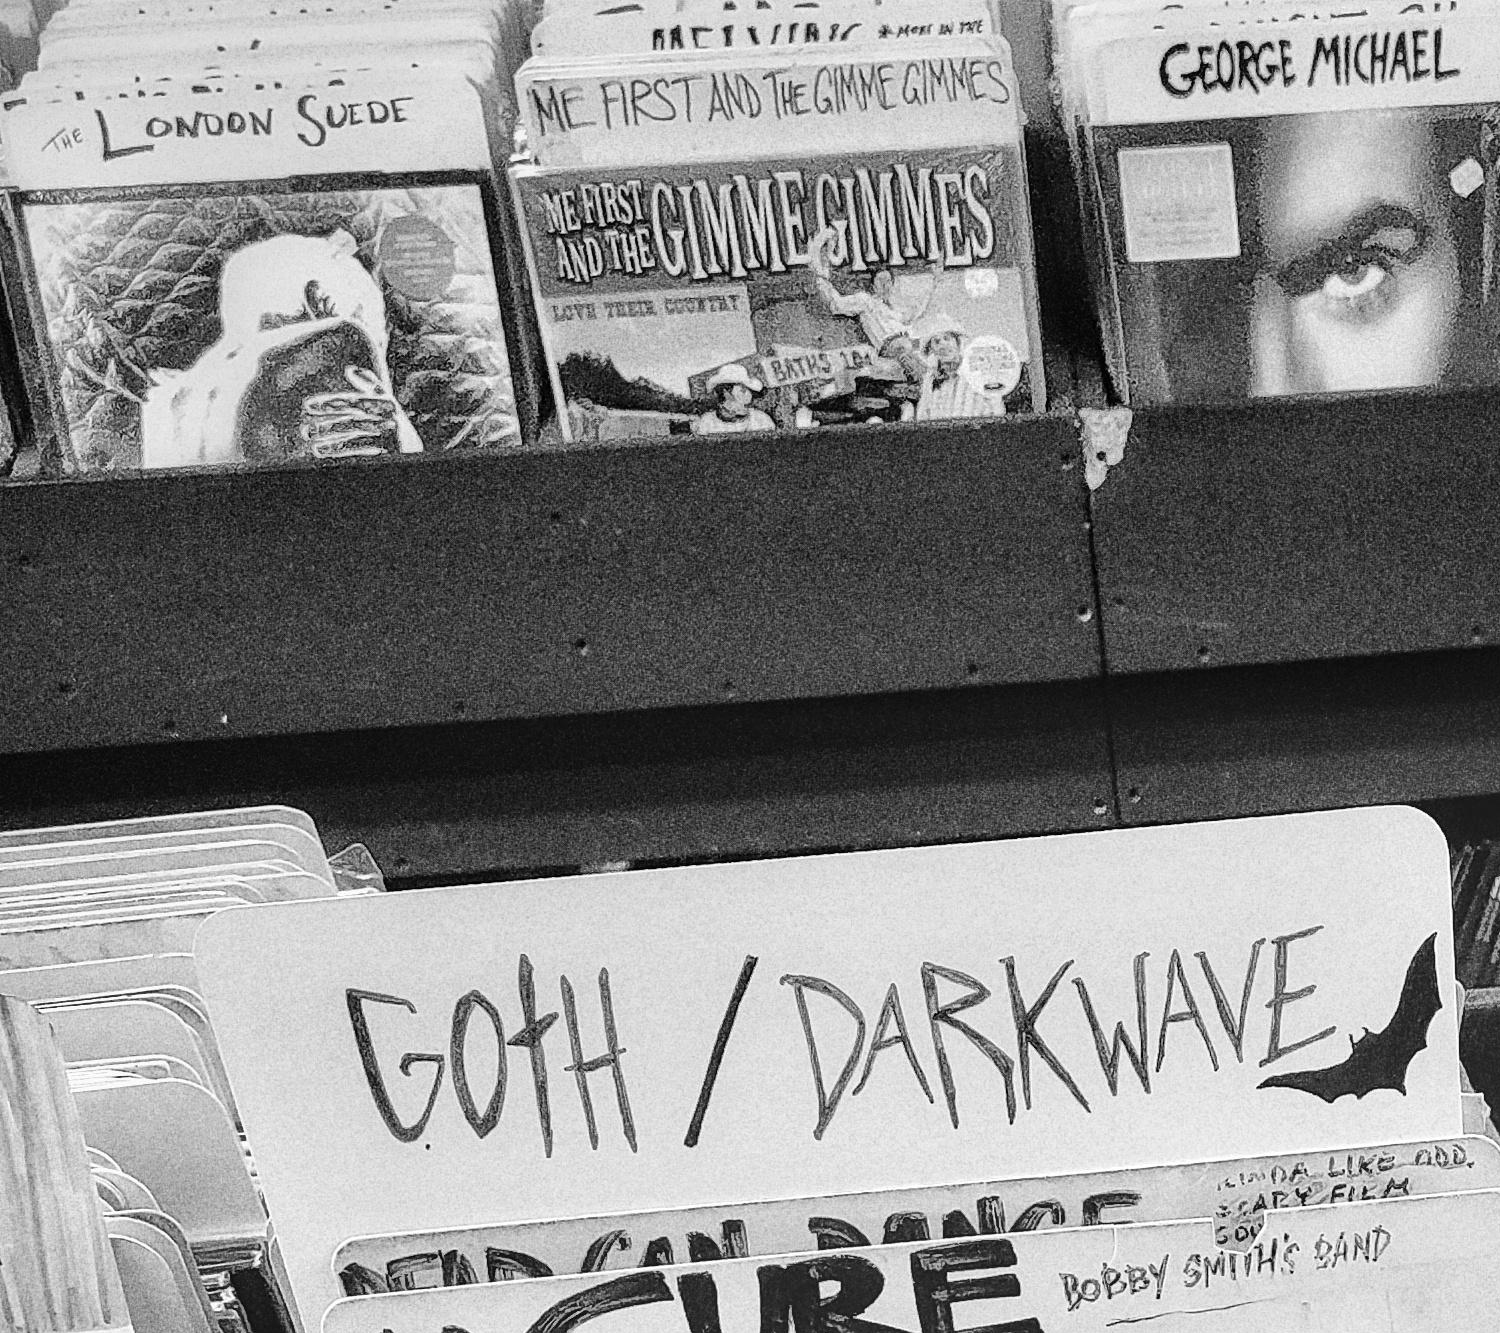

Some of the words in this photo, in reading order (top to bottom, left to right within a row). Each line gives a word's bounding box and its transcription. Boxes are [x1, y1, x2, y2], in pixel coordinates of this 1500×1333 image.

[527, 84, 597, 137] ME
[600, 75, 703, 128] FIRST
[708, 71, 763, 123] AND
[814, 63, 896, 115] GIMME
[902, 56, 1011, 107] GIMMES
[1160, 39, 1296, 98] GEORGE
[1307, 28, 1461, 88] MICHAEL
[95, 107, 274, 162] LONDON
[297, 94, 414, 147] SUEDE
[543, 188, 581, 236] ME
[581, 179, 645, 228] FIRST
[650, 169, 815, 281] GIMME
[814, 162, 996, 271] GIMMES
[557, 234, 604, 284] AND
[604, 225, 656, 275] THE
[779, 924, 1338, 1142] DARKWAVE
[1059, 1254, 1169, 1312] BOBBY
